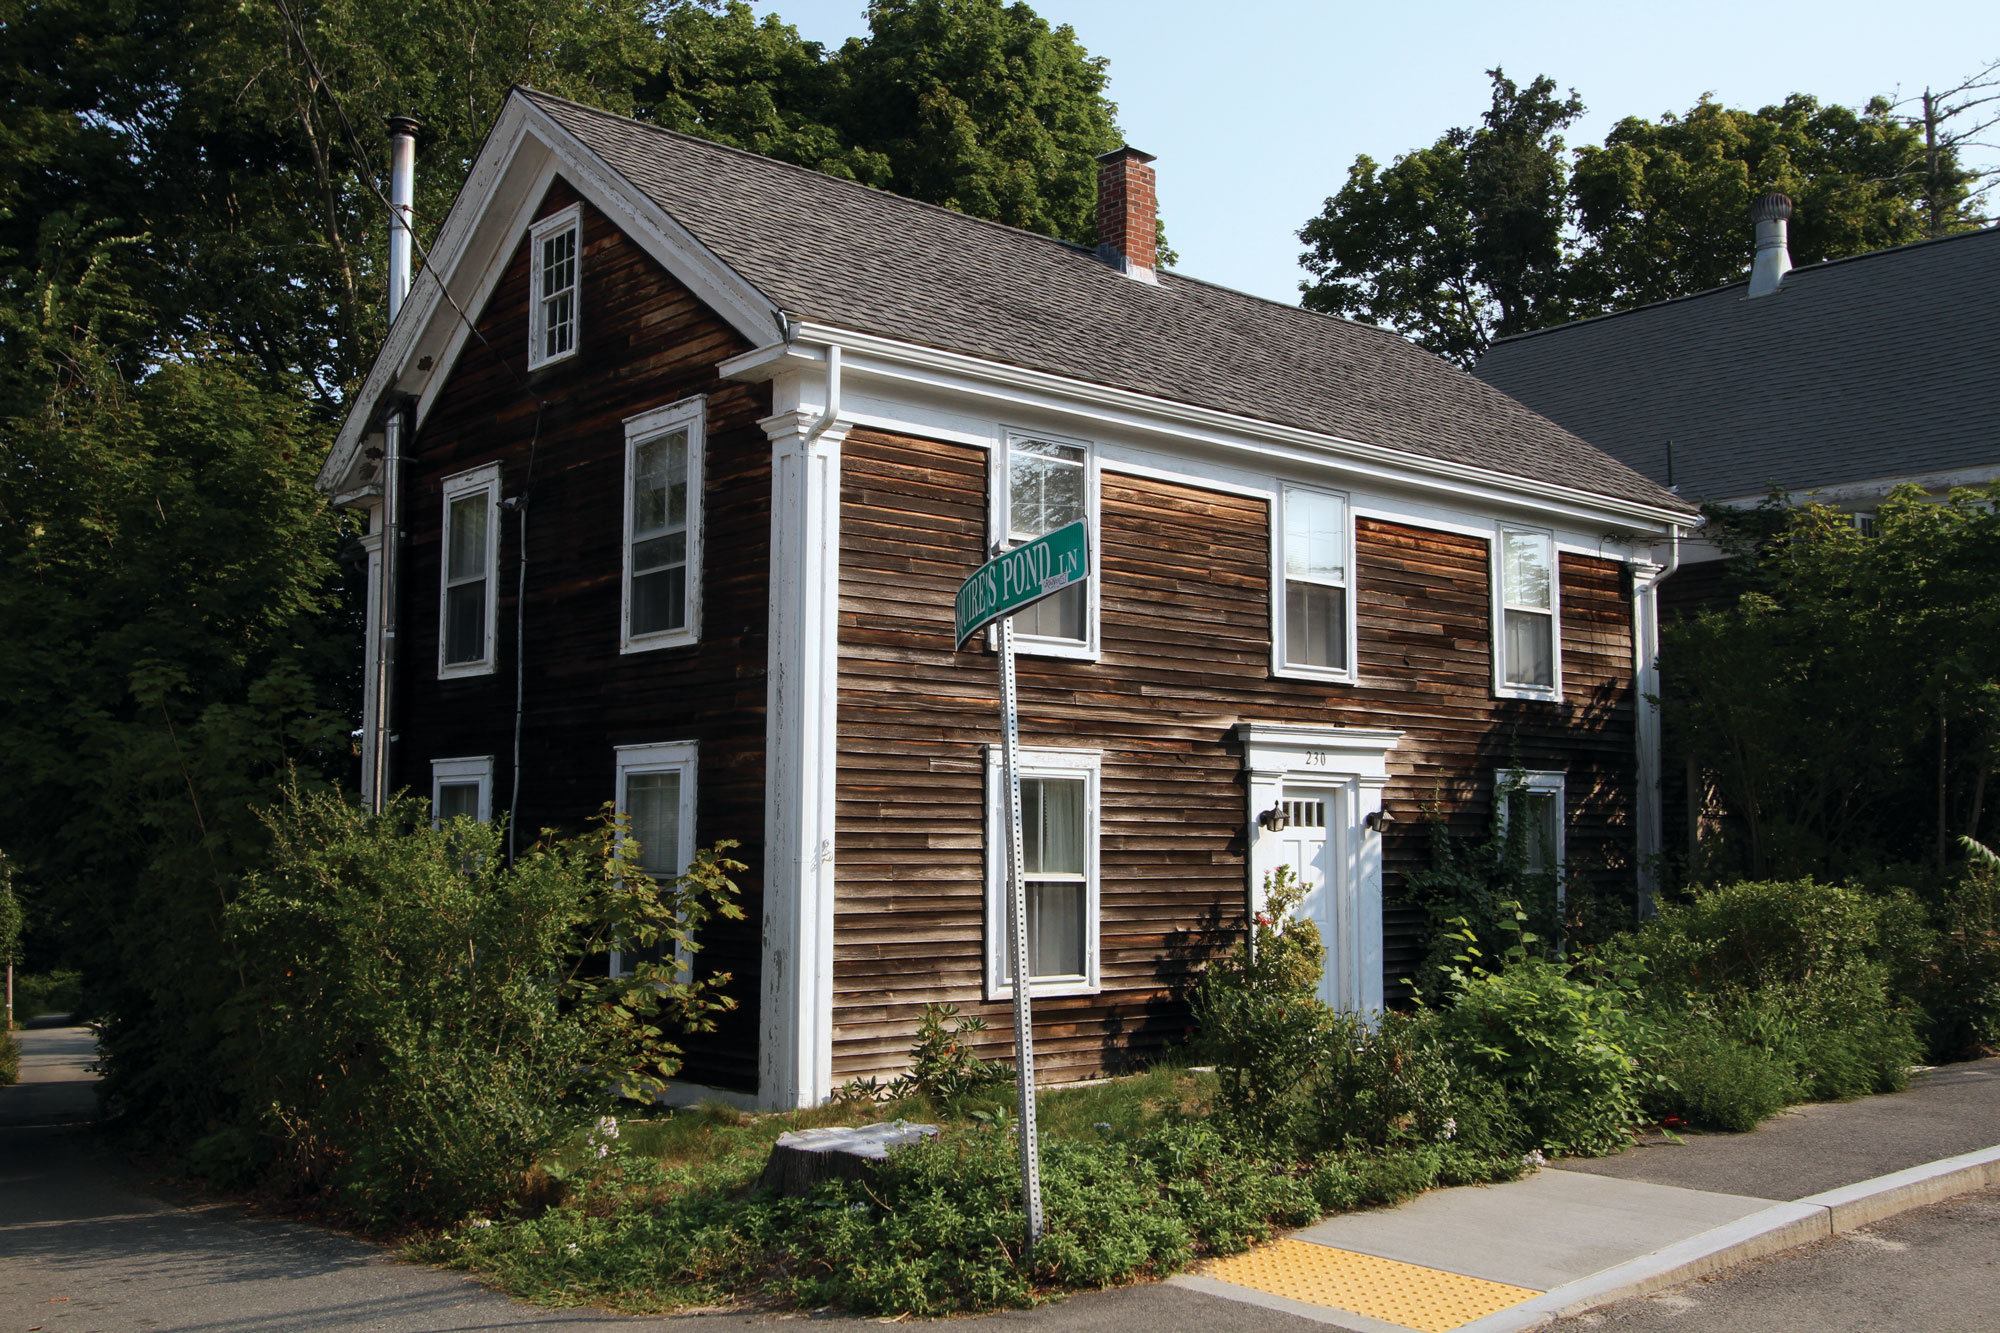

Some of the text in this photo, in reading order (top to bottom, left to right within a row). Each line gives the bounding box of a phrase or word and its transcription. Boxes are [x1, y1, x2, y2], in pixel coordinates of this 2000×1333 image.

[1002, 541, 1051, 601] POND
[1058, 548, 1078, 575] LN
[1305, 751, 1326, 766] 230
